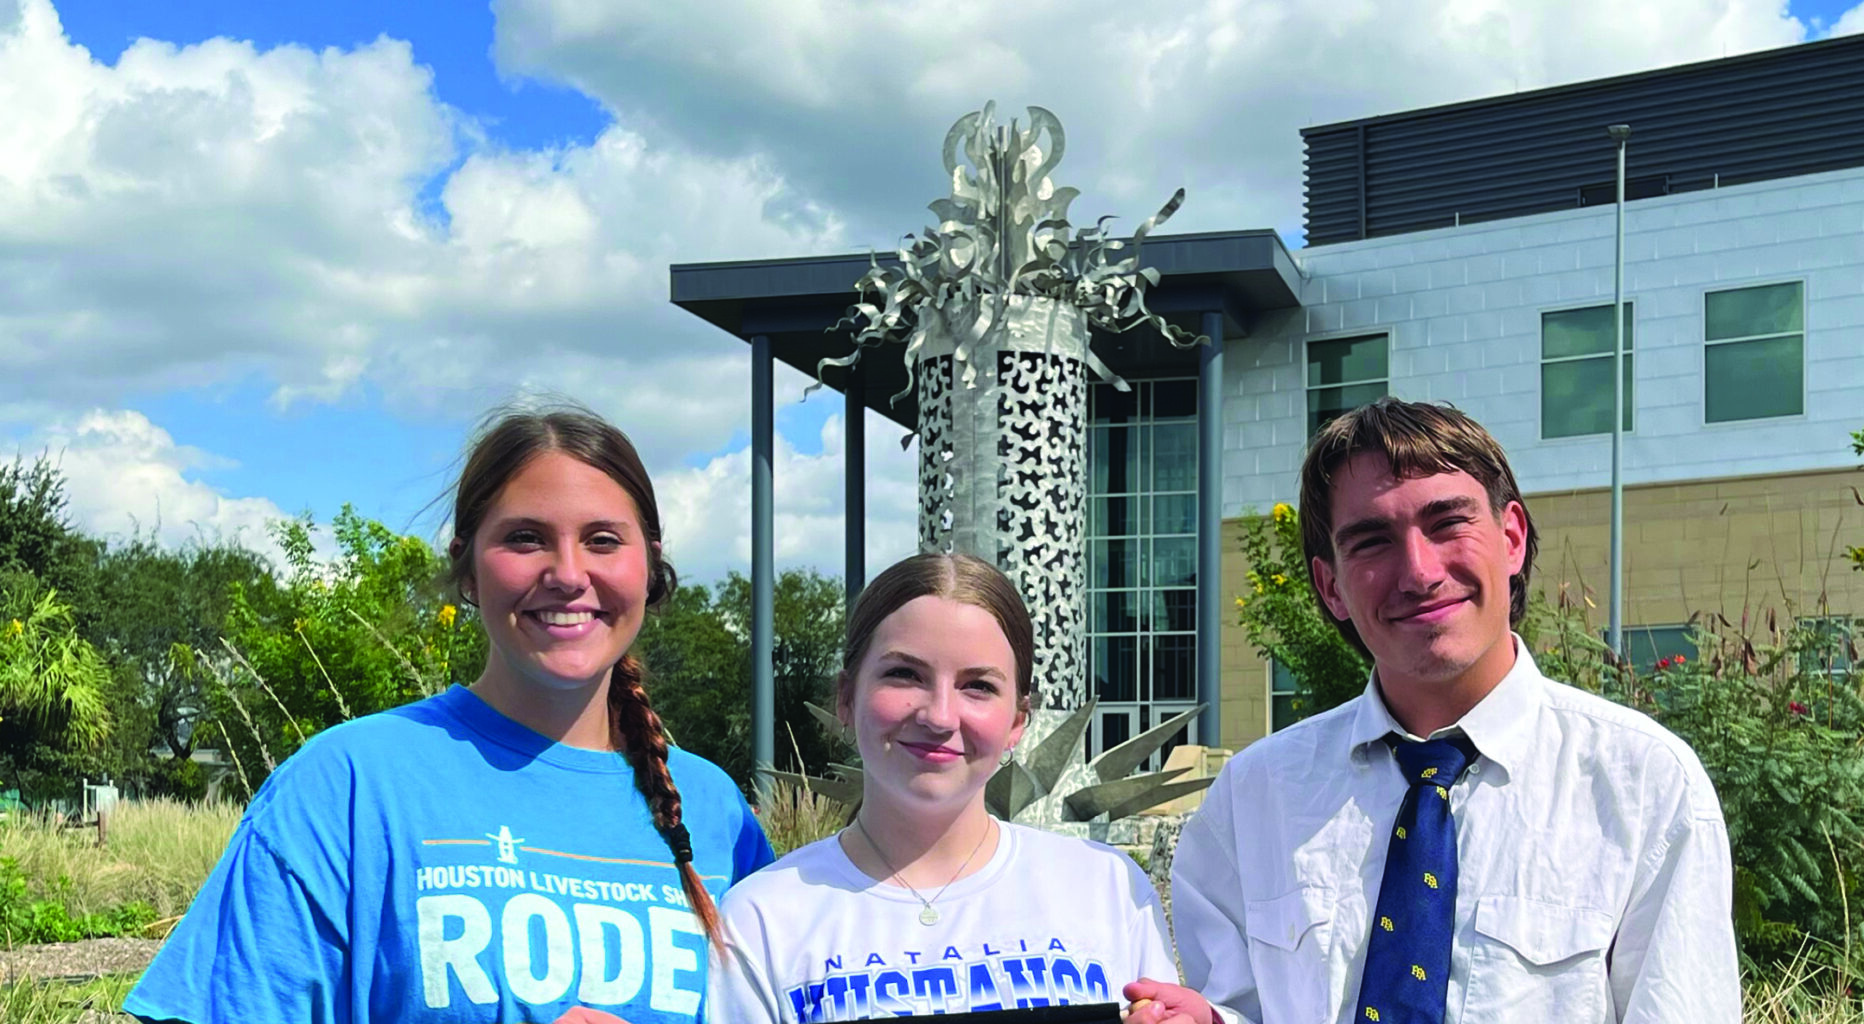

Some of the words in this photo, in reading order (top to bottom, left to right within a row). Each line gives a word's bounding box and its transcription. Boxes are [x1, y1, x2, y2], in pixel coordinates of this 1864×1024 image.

[417, 865, 526, 891] HOUSTON
[530, 871, 658, 902] LIVESTOCK
[416, 893, 709, 1017] RODE
[825, 937, 1067, 972] NATALIA
